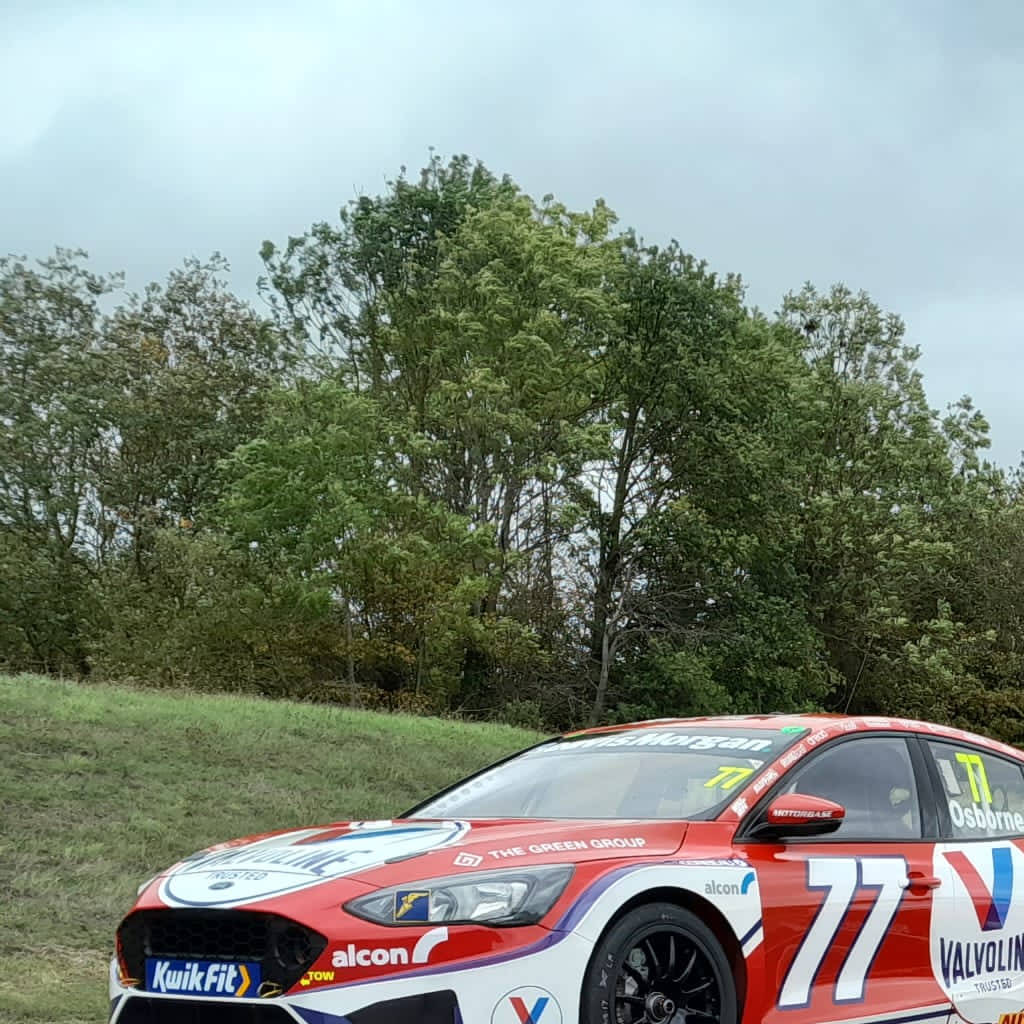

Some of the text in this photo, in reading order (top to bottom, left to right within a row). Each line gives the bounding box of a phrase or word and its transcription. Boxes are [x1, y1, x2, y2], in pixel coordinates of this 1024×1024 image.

[704, 766, 752, 789] 77
[955, 752, 992, 804] 77
[949, 800, 1024, 832] Osborne
[488, 837, 646, 859] THE GREEN GROUP
[704, 880, 739, 895] alcon
[777, 855, 911, 1011] 77
[332, 944, 408, 968] alcon
[308, 971, 335, 981] TOW
[974, 978, 1011, 994] TRUSTED
